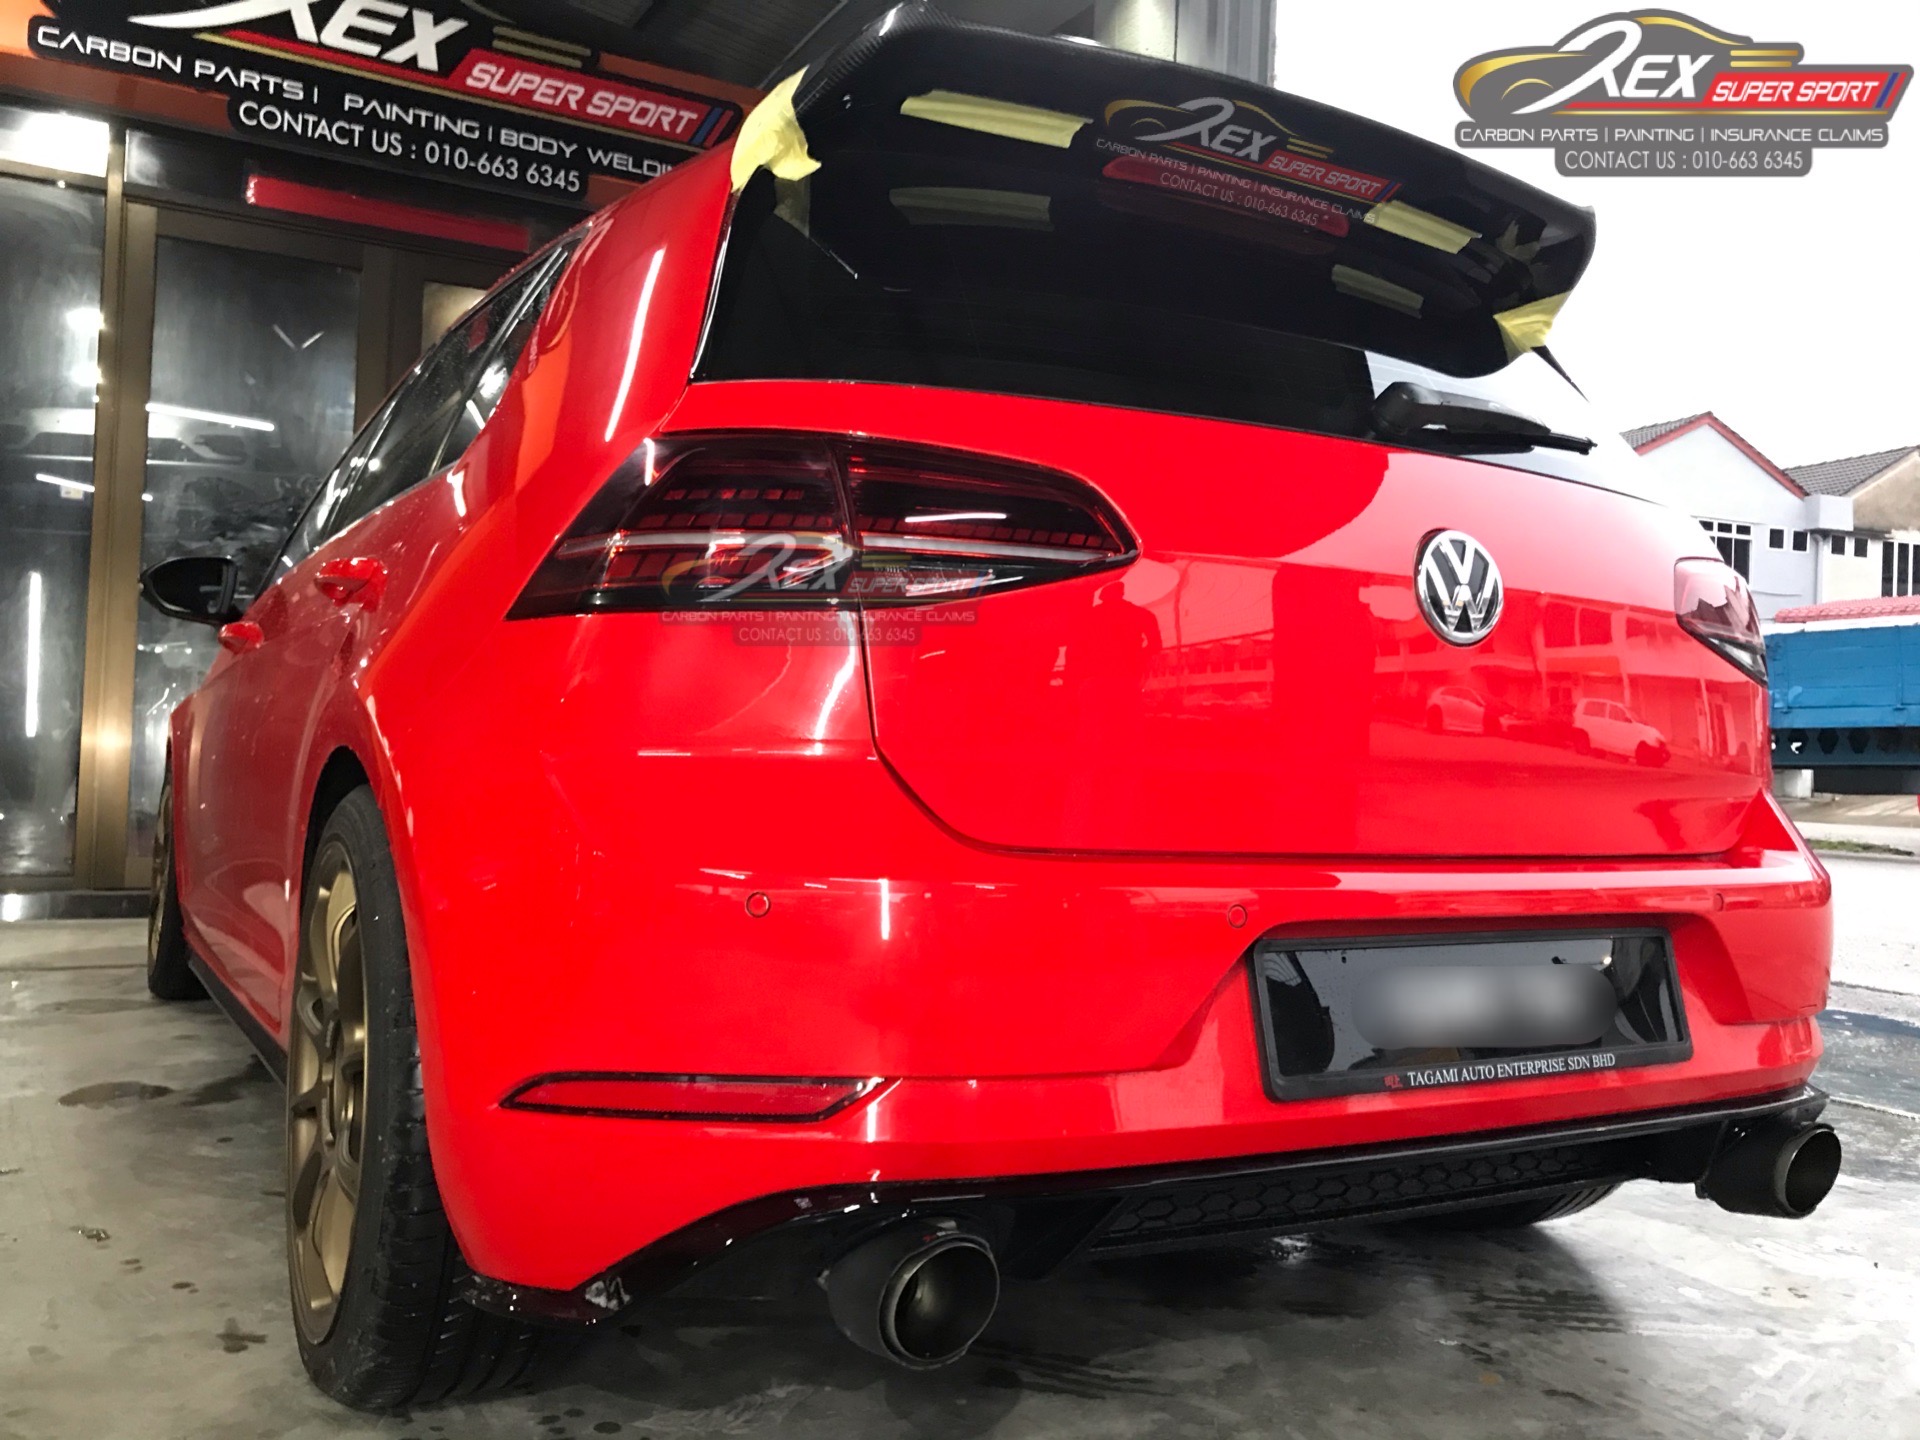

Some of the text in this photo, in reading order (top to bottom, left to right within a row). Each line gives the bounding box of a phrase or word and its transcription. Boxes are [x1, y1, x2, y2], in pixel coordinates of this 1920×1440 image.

[37, 25, 182, 74] CARBON
[193, 60, 304, 103] PARTS
[343, 92, 480, 140] PAINTING
[500, 127, 579, 159] BODY
[465, 61, 699, 136] SUPER SPORT
[238, 100, 366, 150] CONTACT
[371, 129, 403, 157] US
[424, 140, 520, 181] 010-663
[525, 163, 581, 193] 6345
[1407, 1068, 1459, 1087] TAGAMI
[1460, 1064, 1496, 1082] AUTO
[1497, 1056, 1567, 1078] ENTERPRISE
[1567, 1054, 1591, 1070] SDN
[1592, 1053, 1616, 1068] BHD
